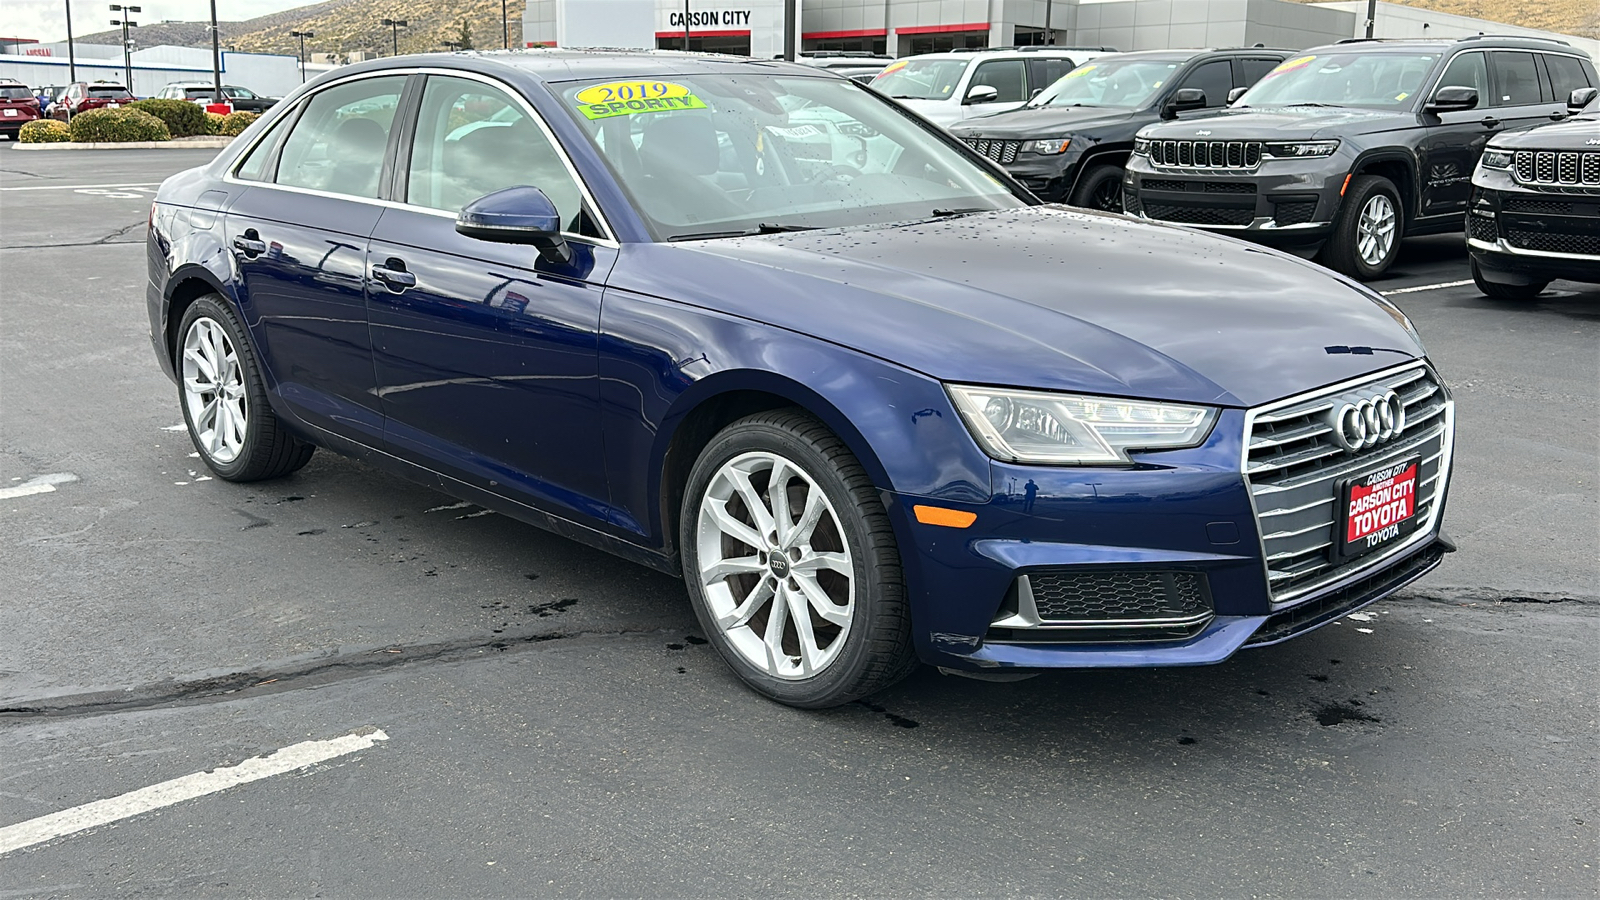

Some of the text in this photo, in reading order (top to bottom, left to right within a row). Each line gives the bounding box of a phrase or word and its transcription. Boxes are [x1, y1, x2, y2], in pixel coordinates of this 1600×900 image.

[670, 10, 751, 27] CARSON CITY
[598, 82, 668, 103] 2019
[589, 96, 692, 115] SPORTY
[1367, 462, 1408, 486] CARSON CITY
[1372, 478, 1394, 492] ANOTHER
[1349, 478, 1416, 517] CARSON CITY
[1354, 498, 1407, 536] TOYOTA
[1366, 523, 1399, 548] TOYOTA
